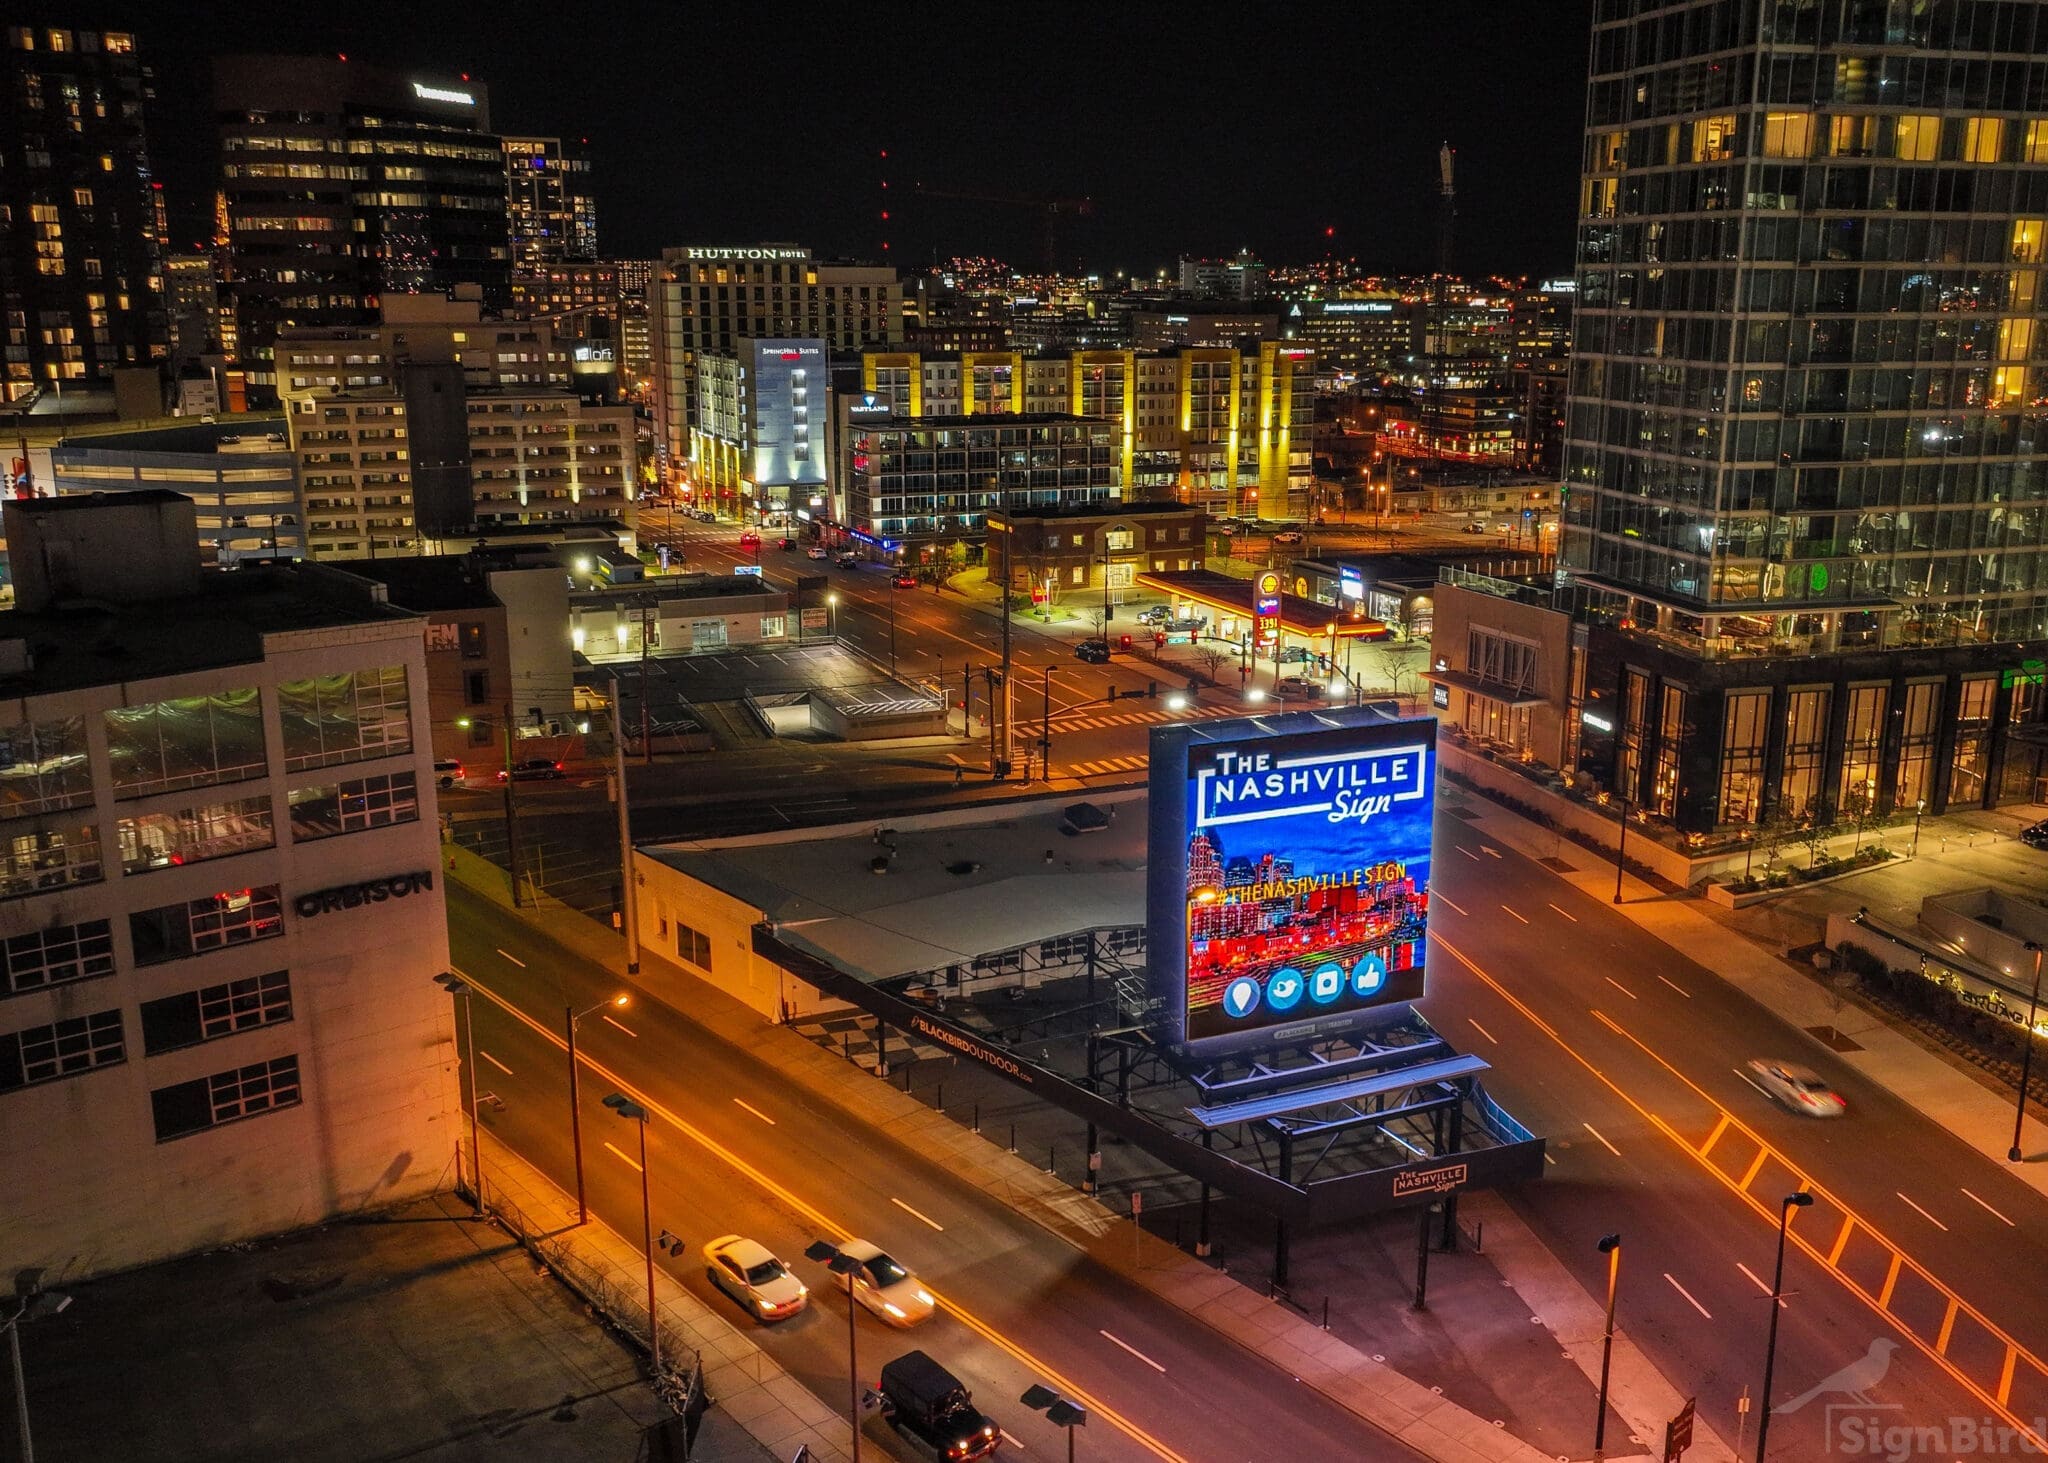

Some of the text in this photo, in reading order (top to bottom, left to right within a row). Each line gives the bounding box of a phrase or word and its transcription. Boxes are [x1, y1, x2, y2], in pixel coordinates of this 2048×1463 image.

[688, 248, 777, 260] HUTTON
[1216, 751, 1271, 776] THE
[1215, 758, 1409, 804] NASHVILLE
[1327, 787, 1391, 825] Sign
[295, 870, 434, 918] ORBISON
[1216, 861, 1407, 906] #THENASHVILLESIGN
[1399, 1168, 1462, 1190] NASHVILLE
[1400, 1171, 1417, 1181] THE
[1434, 1181, 1457, 1193] Sign
